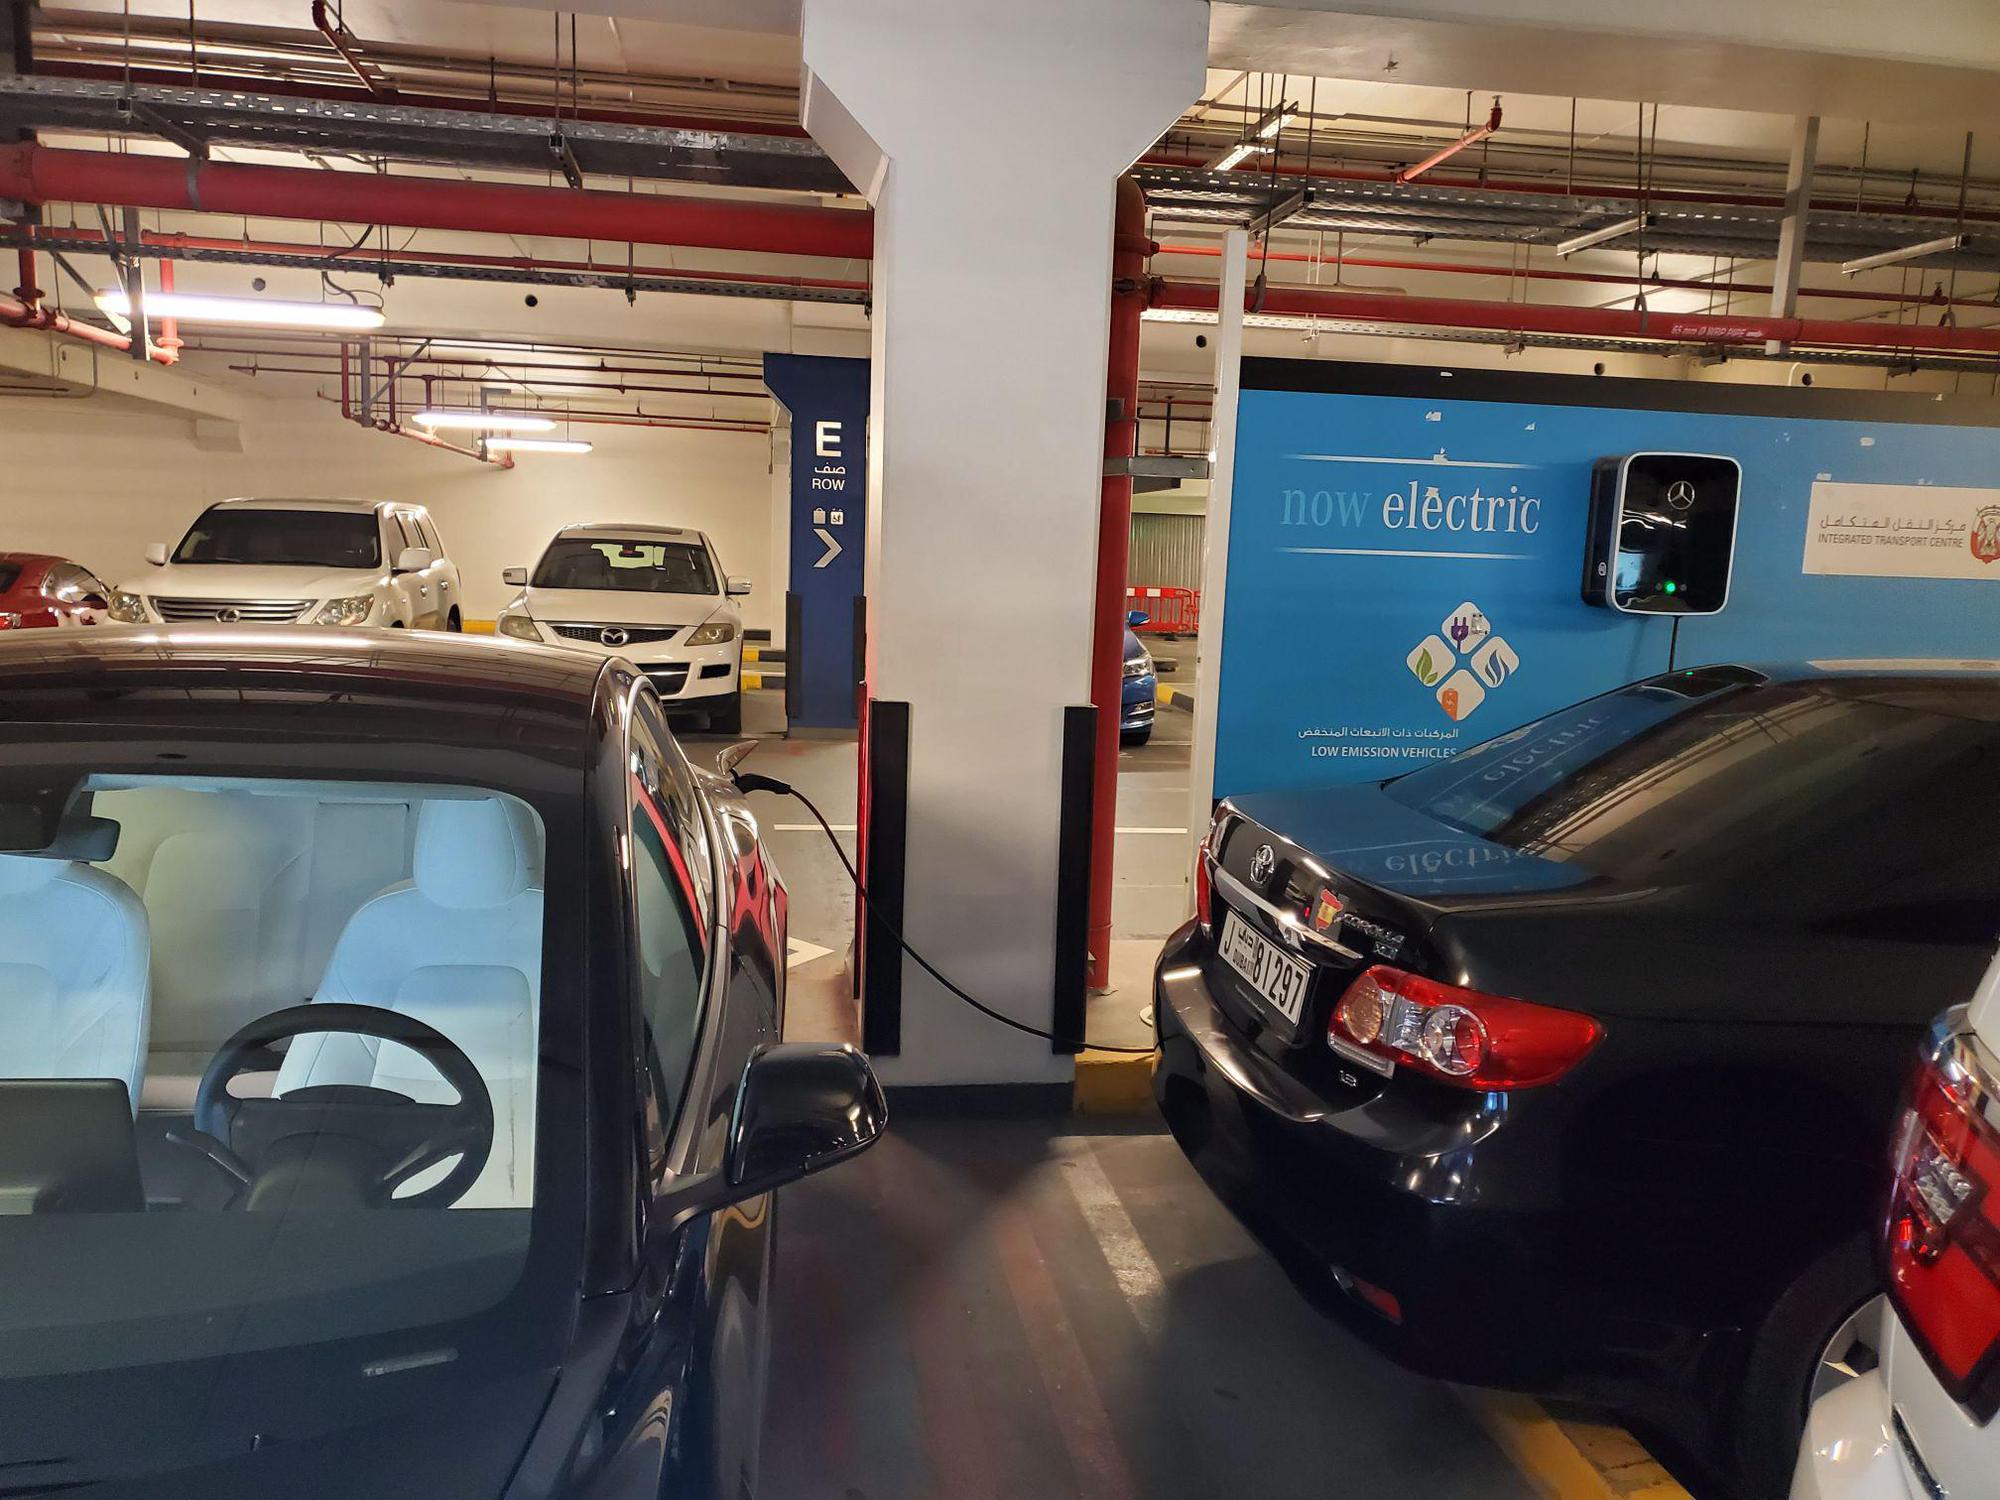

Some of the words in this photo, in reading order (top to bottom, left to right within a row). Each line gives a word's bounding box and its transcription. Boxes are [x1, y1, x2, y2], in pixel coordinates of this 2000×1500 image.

[1727, 328, 1746, 337] PIPE
[816, 421, 842, 457] E
[814, 462, 846, 474] صف
[812, 478, 846, 491] ROW
[1281, 487, 1373, 528] now
[1382, 480, 1542, 534] electric
[1893, 517, 1933, 532] النقل
[1935, 519, 1967, 534] مركز
[1818, 533, 1873, 545] INTEGRATED
[1875, 535, 1928, 547] TRANSPORT
[1930, 537, 1963, 548] CENTRE
[1298, 726, 1348, 739] المنخفض
[1392, 728, 1412, 738] ذات
[1414, 728, 1459, 740] المركبات
[1311, 746, 1340, 757] LOW
[1342, 747, 1399, 758] EMISSION
[1401, 747, 1457, 758] VEHICLES
[1224, 920, 1236, 955] J
[1252, 941, 1304, 1015] 81297
